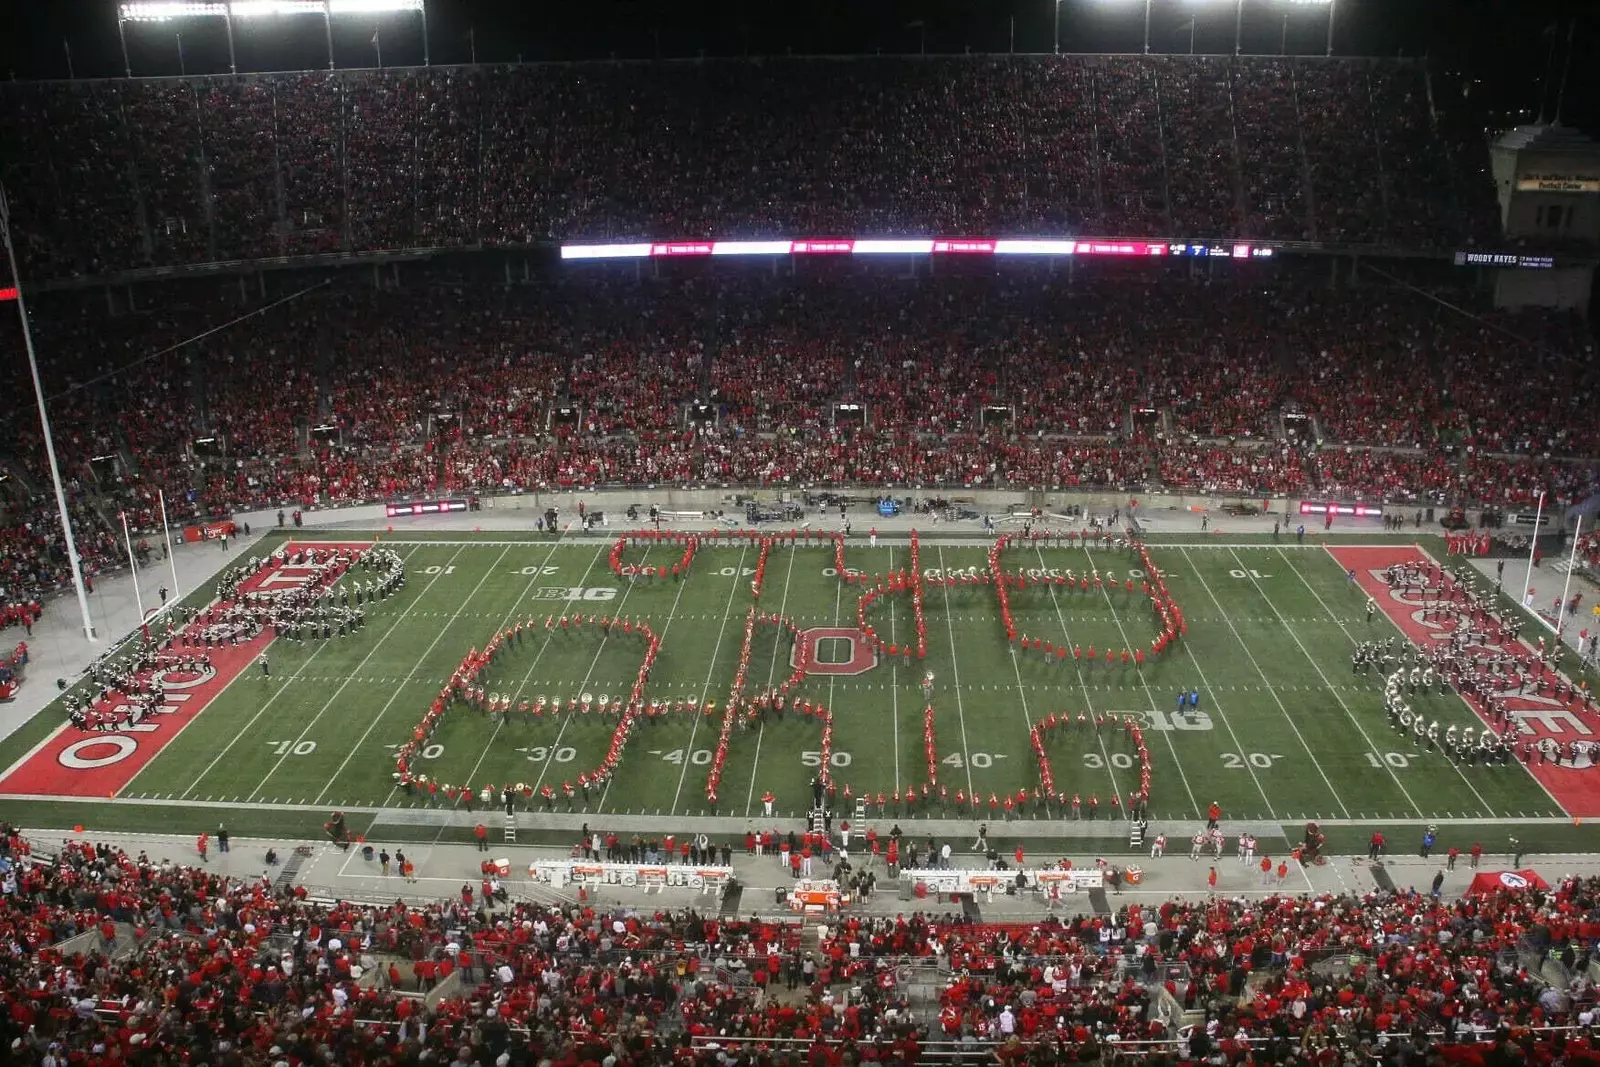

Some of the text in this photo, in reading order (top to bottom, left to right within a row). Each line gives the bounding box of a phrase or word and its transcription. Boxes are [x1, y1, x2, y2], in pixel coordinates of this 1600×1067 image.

[1467, 253, 1493, 262] WOODY
[1494, 255, 1517, 263] HAYES
[273, 740, 317, 755] 10
[527, 747, 577, 762] 30
[662, 749, 712, 764] 40
[801, 751, 851, 766] 50
[942, 752, 993, 768] 40
[1083, 753, 1133, 768] 30
[1219, 753, 1272, 768] 20
[1364, 752, 1410, 767] 10
